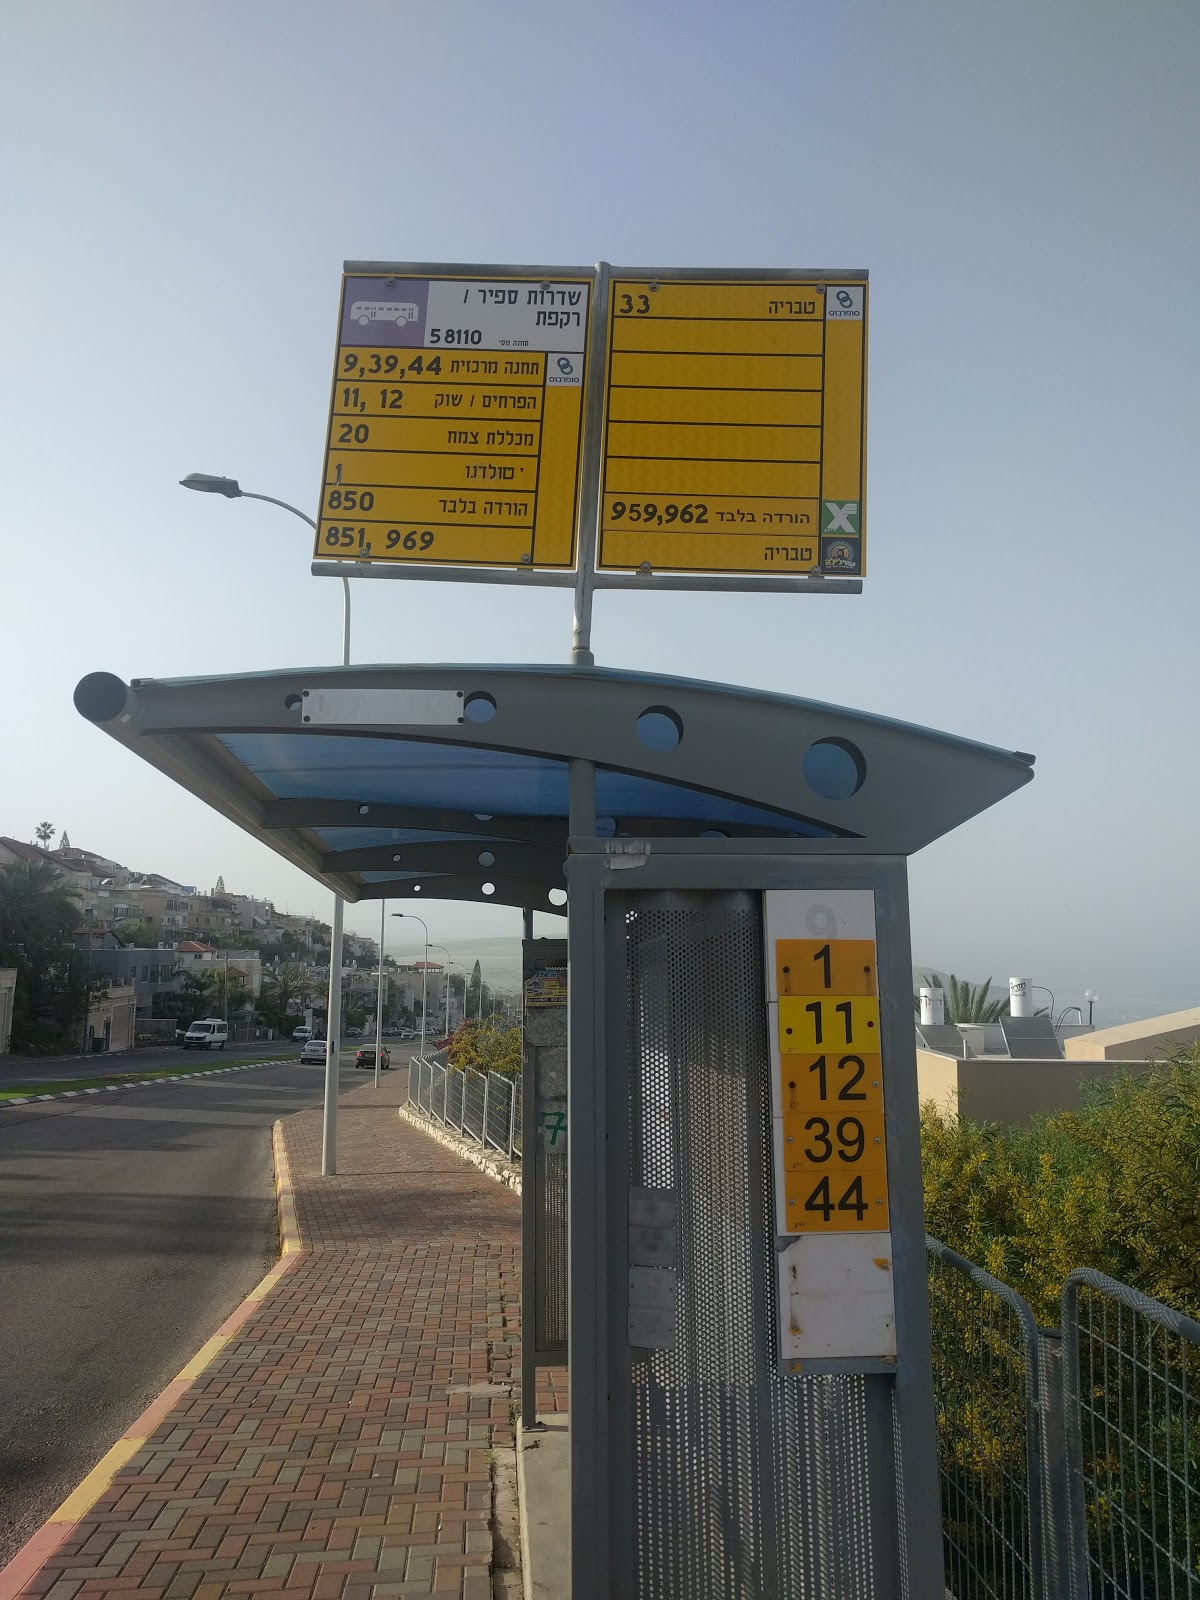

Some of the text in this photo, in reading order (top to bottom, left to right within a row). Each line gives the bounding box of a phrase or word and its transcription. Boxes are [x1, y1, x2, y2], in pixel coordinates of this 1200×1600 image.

[478, 290, 518, 304] ספיר
[527, 289, 581, 306] שדרות
[619, 294, 650, 314] 33
[769, 301, 815, 314] טבריה
[535, 310, 581, 327] רקפת
[343, 354, 441, 378] 9,39,44
[450, 360, 539, 375] תחנה מרכזית
[549, 376, 580, 384] סופרבוס
[381, 389, 403, 409] 12
[434, 394, 463, 408] שוק
[483, 395, 536, 409] הפרחים
[338, 424, 369, 443] 20
[448, 430, 533, 446] מכללת צמח
[336, 464, 342, 480] 1
[328, 490, 374, 511] 850
[439, 498, 528, 516] הורדה בלבד
[610, 502, 709, 527] 959,962
[716, 509, 810, 524] הורדה בלבד
[386, 530, 434, 551] 969
[765, 547, 812, 561] טבריה
[814, 945, 831, 988] 1
[806, 1001, 852, 1044] 11
[810, 1055, 866, 1100] 12
[541, 1112, 567, 1145] 7
[805, 1117, 864, 1163] 39
[805, 1176, 868, 1221] 44
